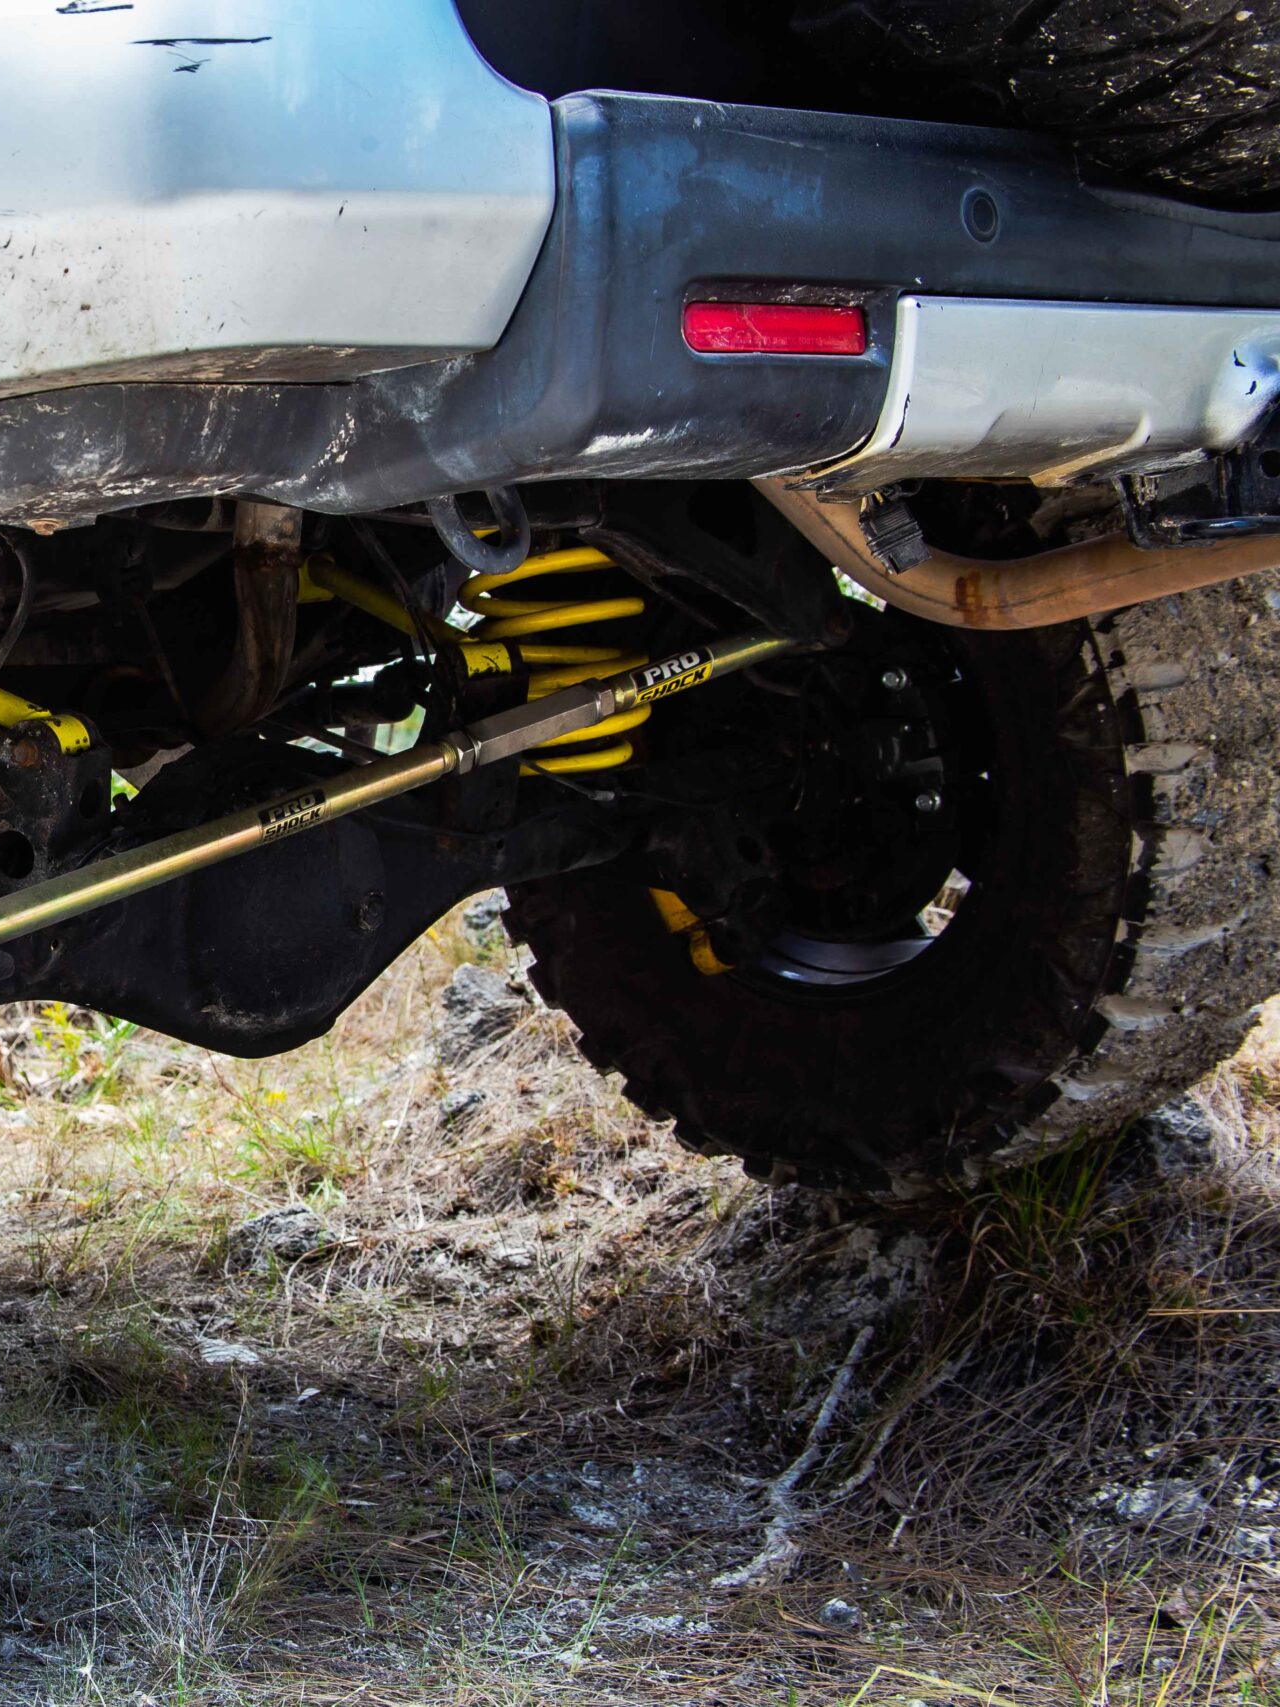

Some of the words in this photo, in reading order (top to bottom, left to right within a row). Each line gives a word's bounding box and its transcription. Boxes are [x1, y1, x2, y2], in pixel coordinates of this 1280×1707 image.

[640, 667, 707, 701] SHOCK
[643, 652, 700, 686] PRO
[266, 807, 321, 837] SHOCK
[268, 793, 316, 823] PRO
